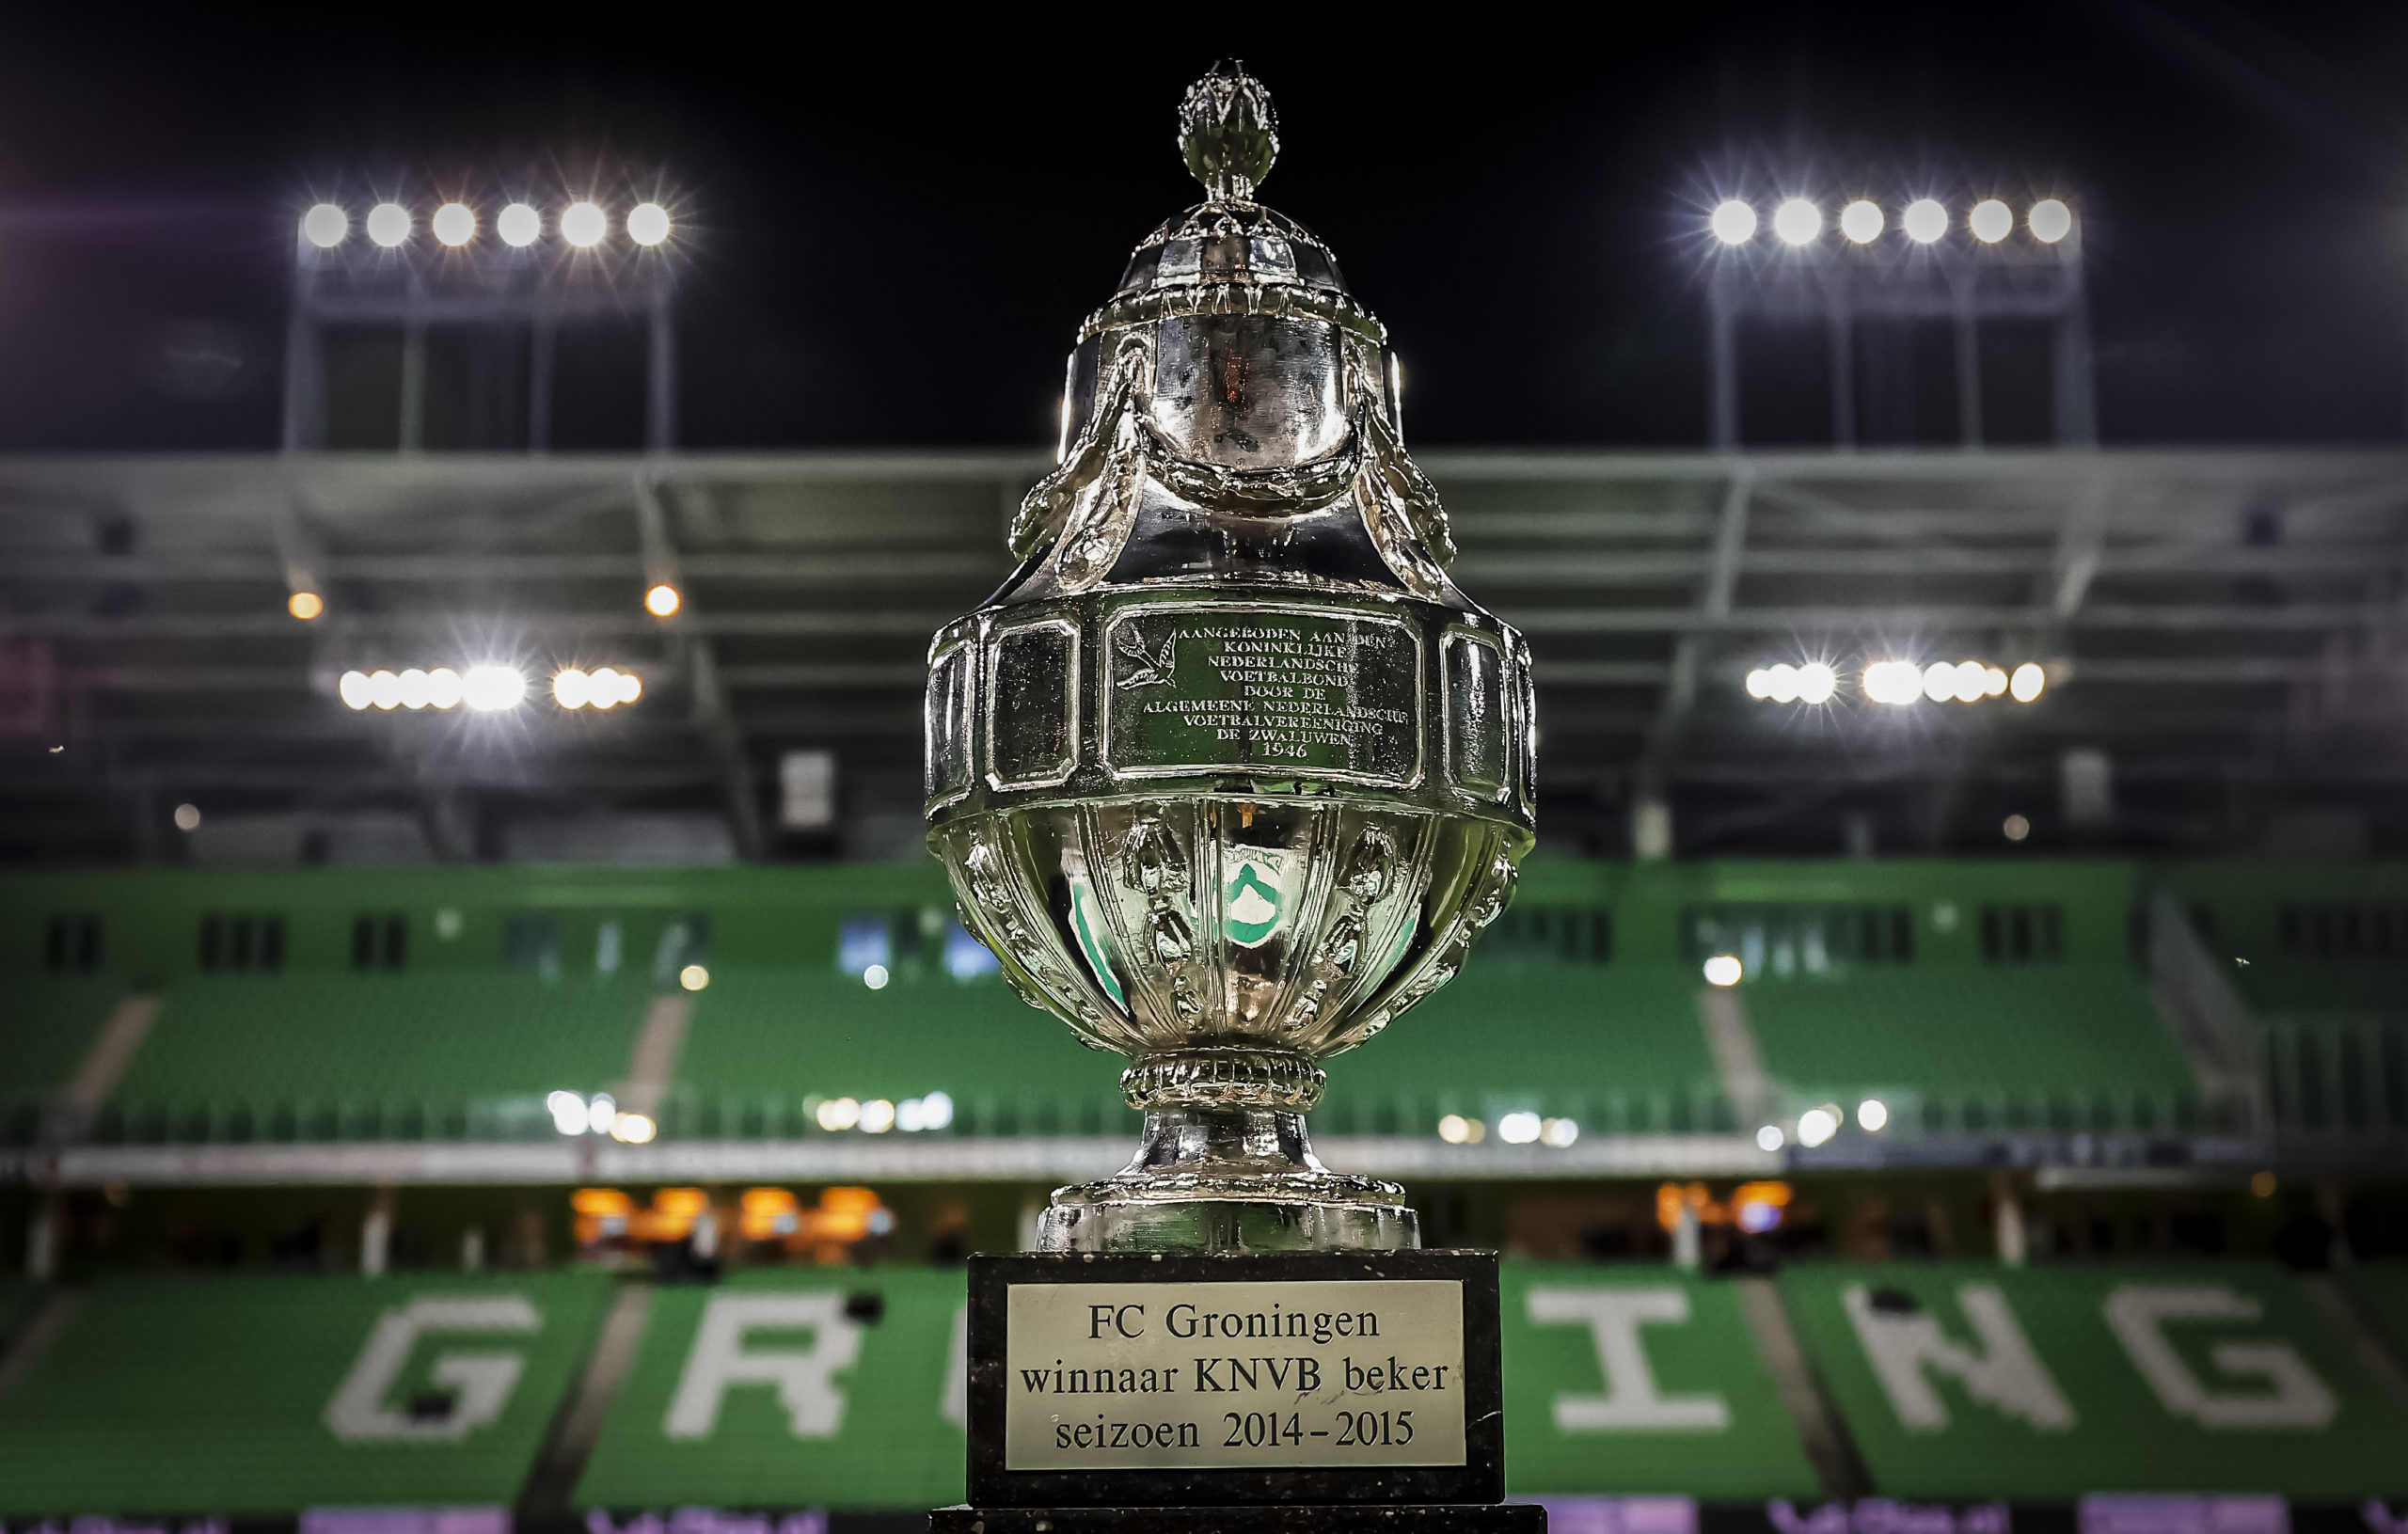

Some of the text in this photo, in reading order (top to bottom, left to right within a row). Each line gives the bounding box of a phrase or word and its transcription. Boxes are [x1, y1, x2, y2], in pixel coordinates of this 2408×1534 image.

[1179, 627, 1300, 641] AANGEBODEN
[1308, 631, 1345, 643] AAN
[1208, 656, 1358, 673] NEDERLANDSCHE
[1220, 670, 1348, 688] VOETBALBOND
[1244, 685, 1326, 701] DOOR DE
[1183, 714, 1384, 735] VOETBALVEREENIGING
[1216, 729, 1351, 746] DE ZWALUWEN
[1262, 742, 1307, 758] 1946
[1088, 1303, 1380, 1344] FC Groningen
[1021, 1356, 1450, 1394] winnaar KNVB beker
[1055, 1413, 1199, 1448] seizoen
